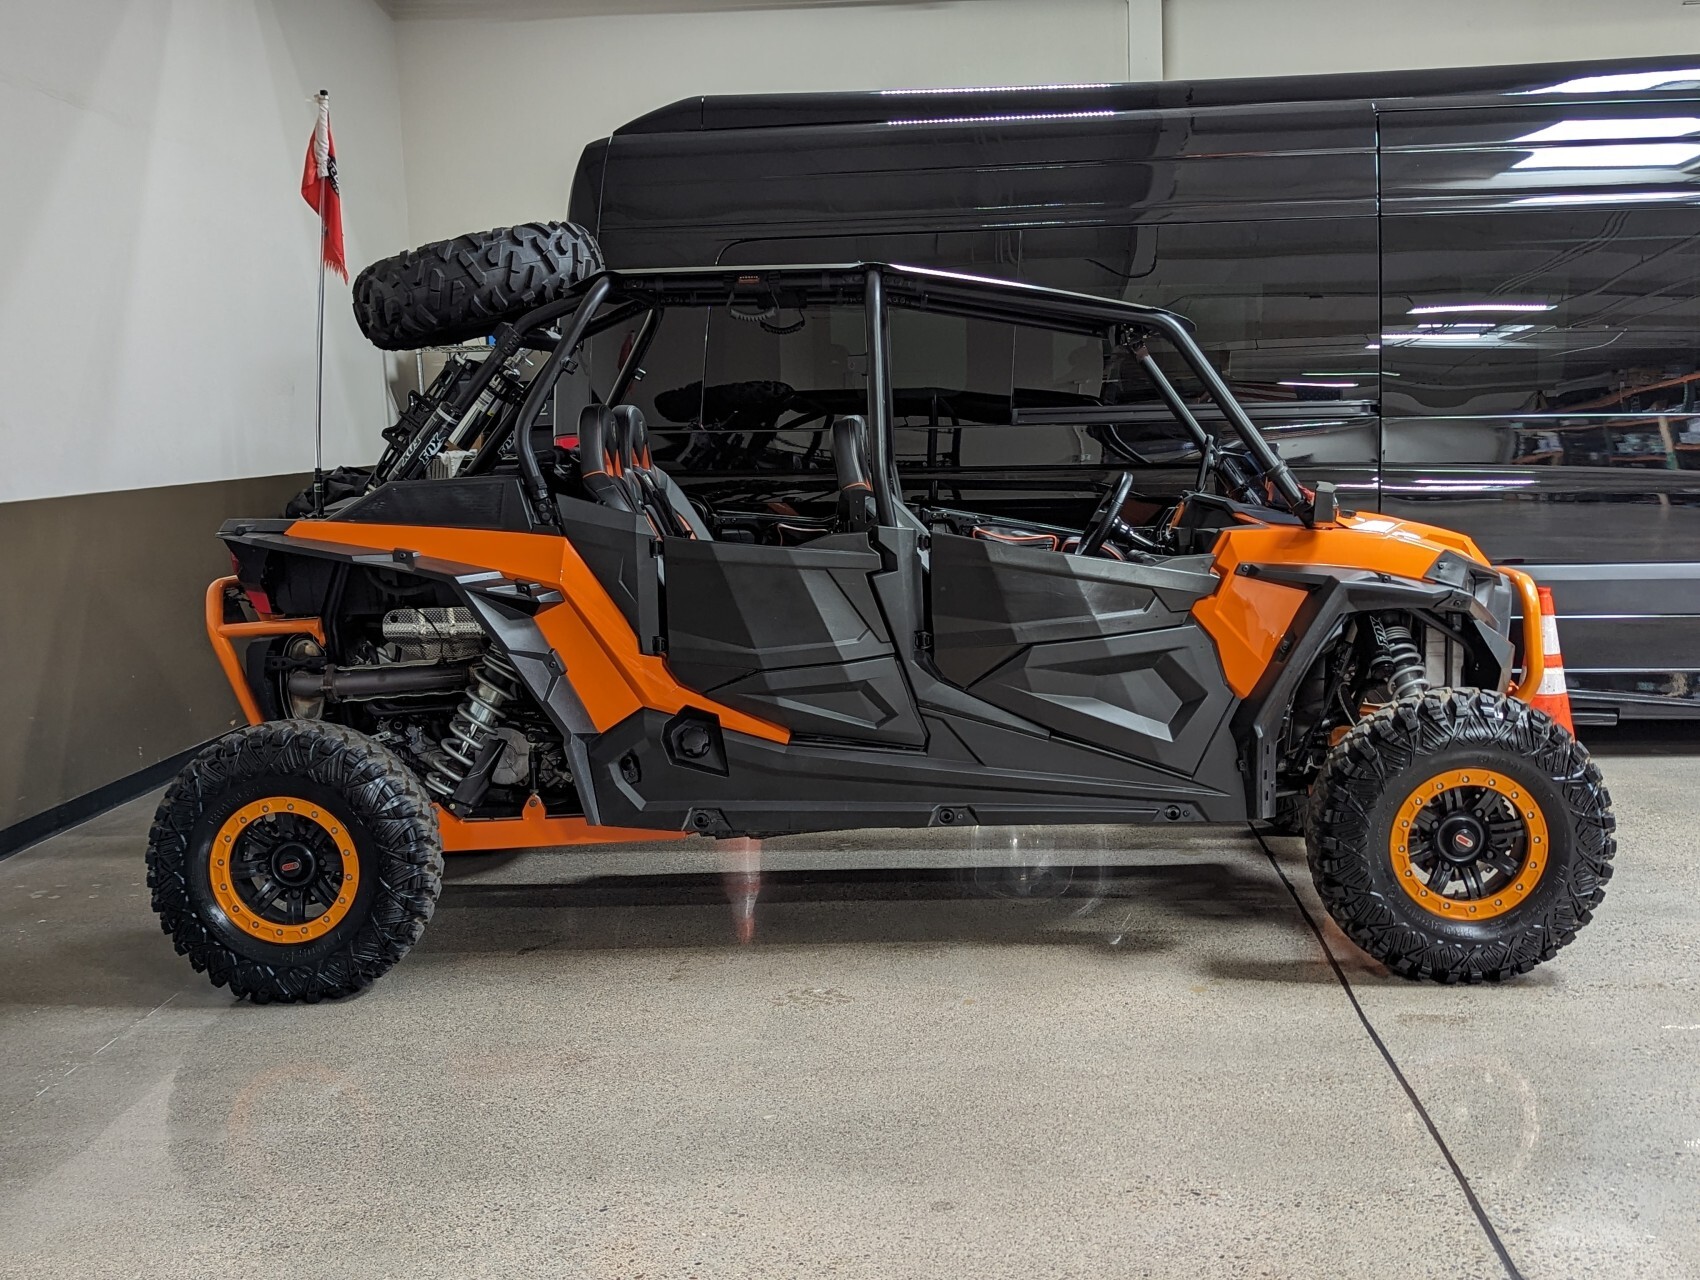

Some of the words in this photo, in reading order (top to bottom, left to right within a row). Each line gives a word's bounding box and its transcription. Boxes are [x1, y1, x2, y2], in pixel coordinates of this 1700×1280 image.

[419, 432, 446, 465] FOX
[498, 431, 516, 458] FOX
[1369, 615, 1390, 650] FOX
